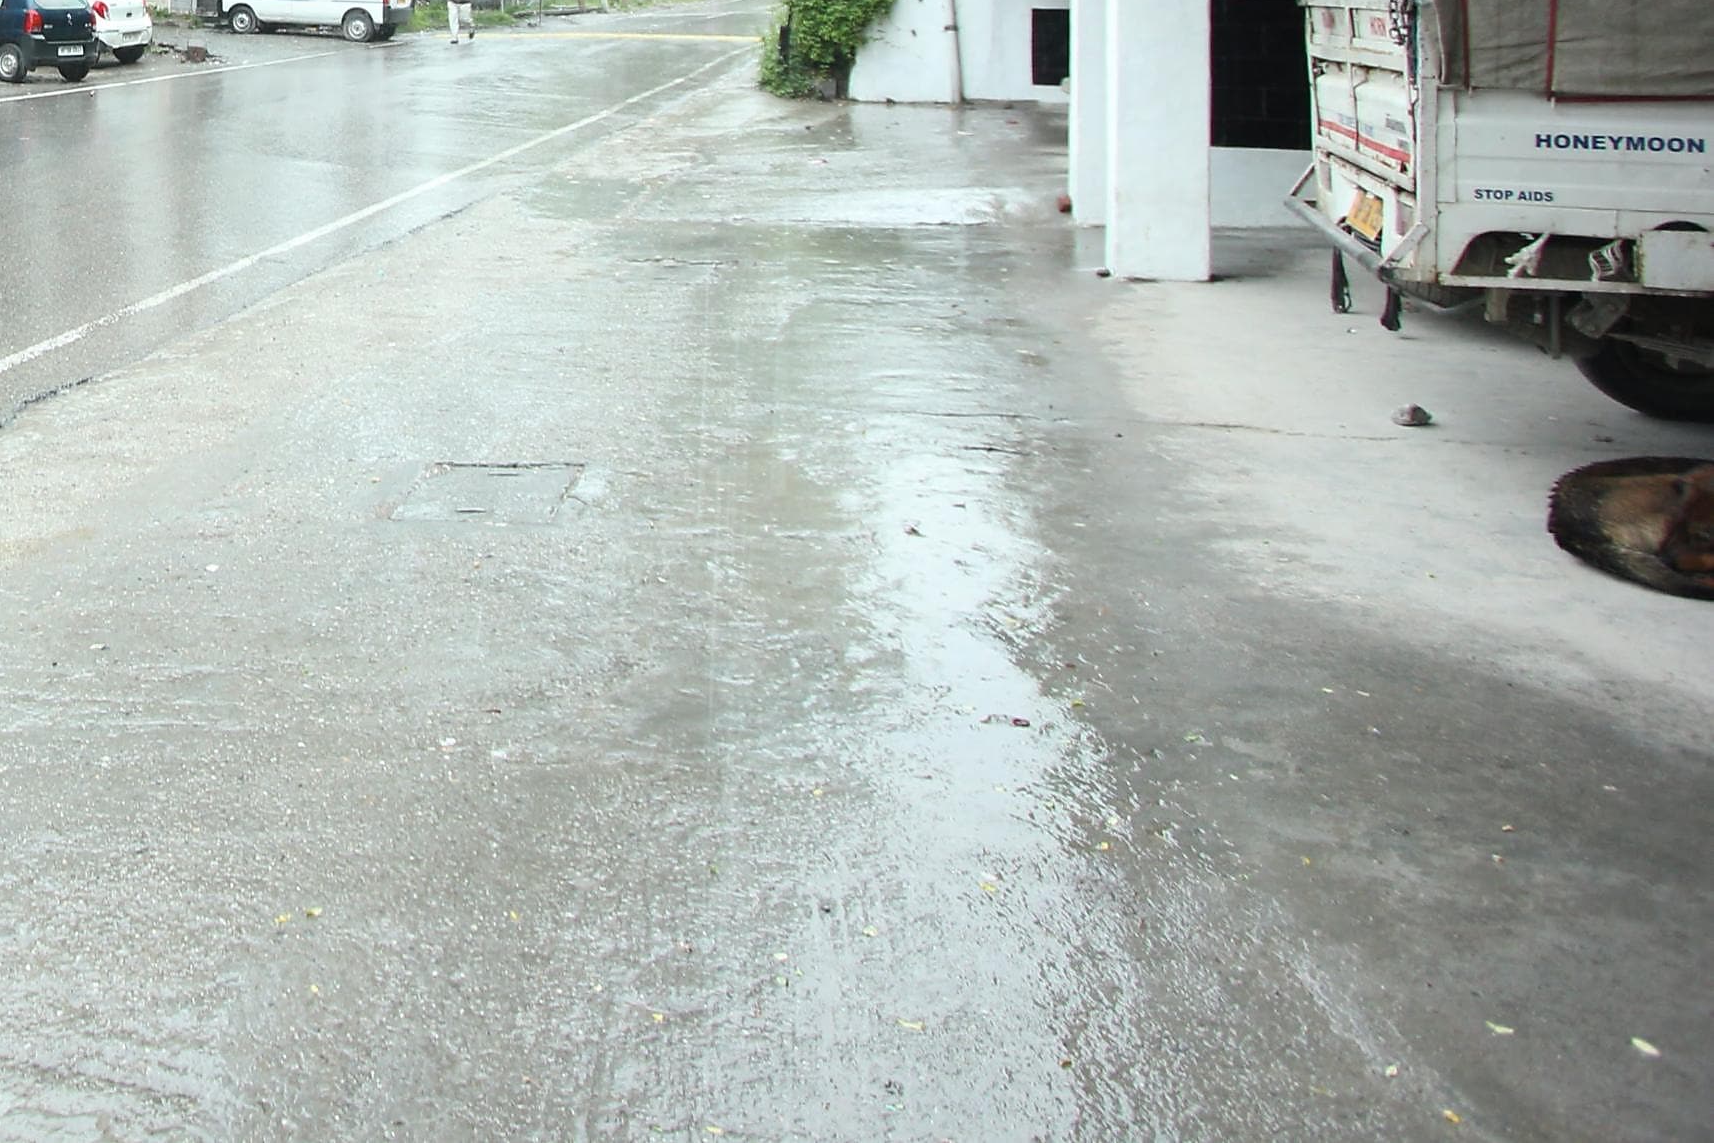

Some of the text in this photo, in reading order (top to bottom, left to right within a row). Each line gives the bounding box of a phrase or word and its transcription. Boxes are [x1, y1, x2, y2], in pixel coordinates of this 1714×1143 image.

[1535, 133, 1706, 154] HONEYMOON
[1473, 188, 1555, 203] STOP AIDS
